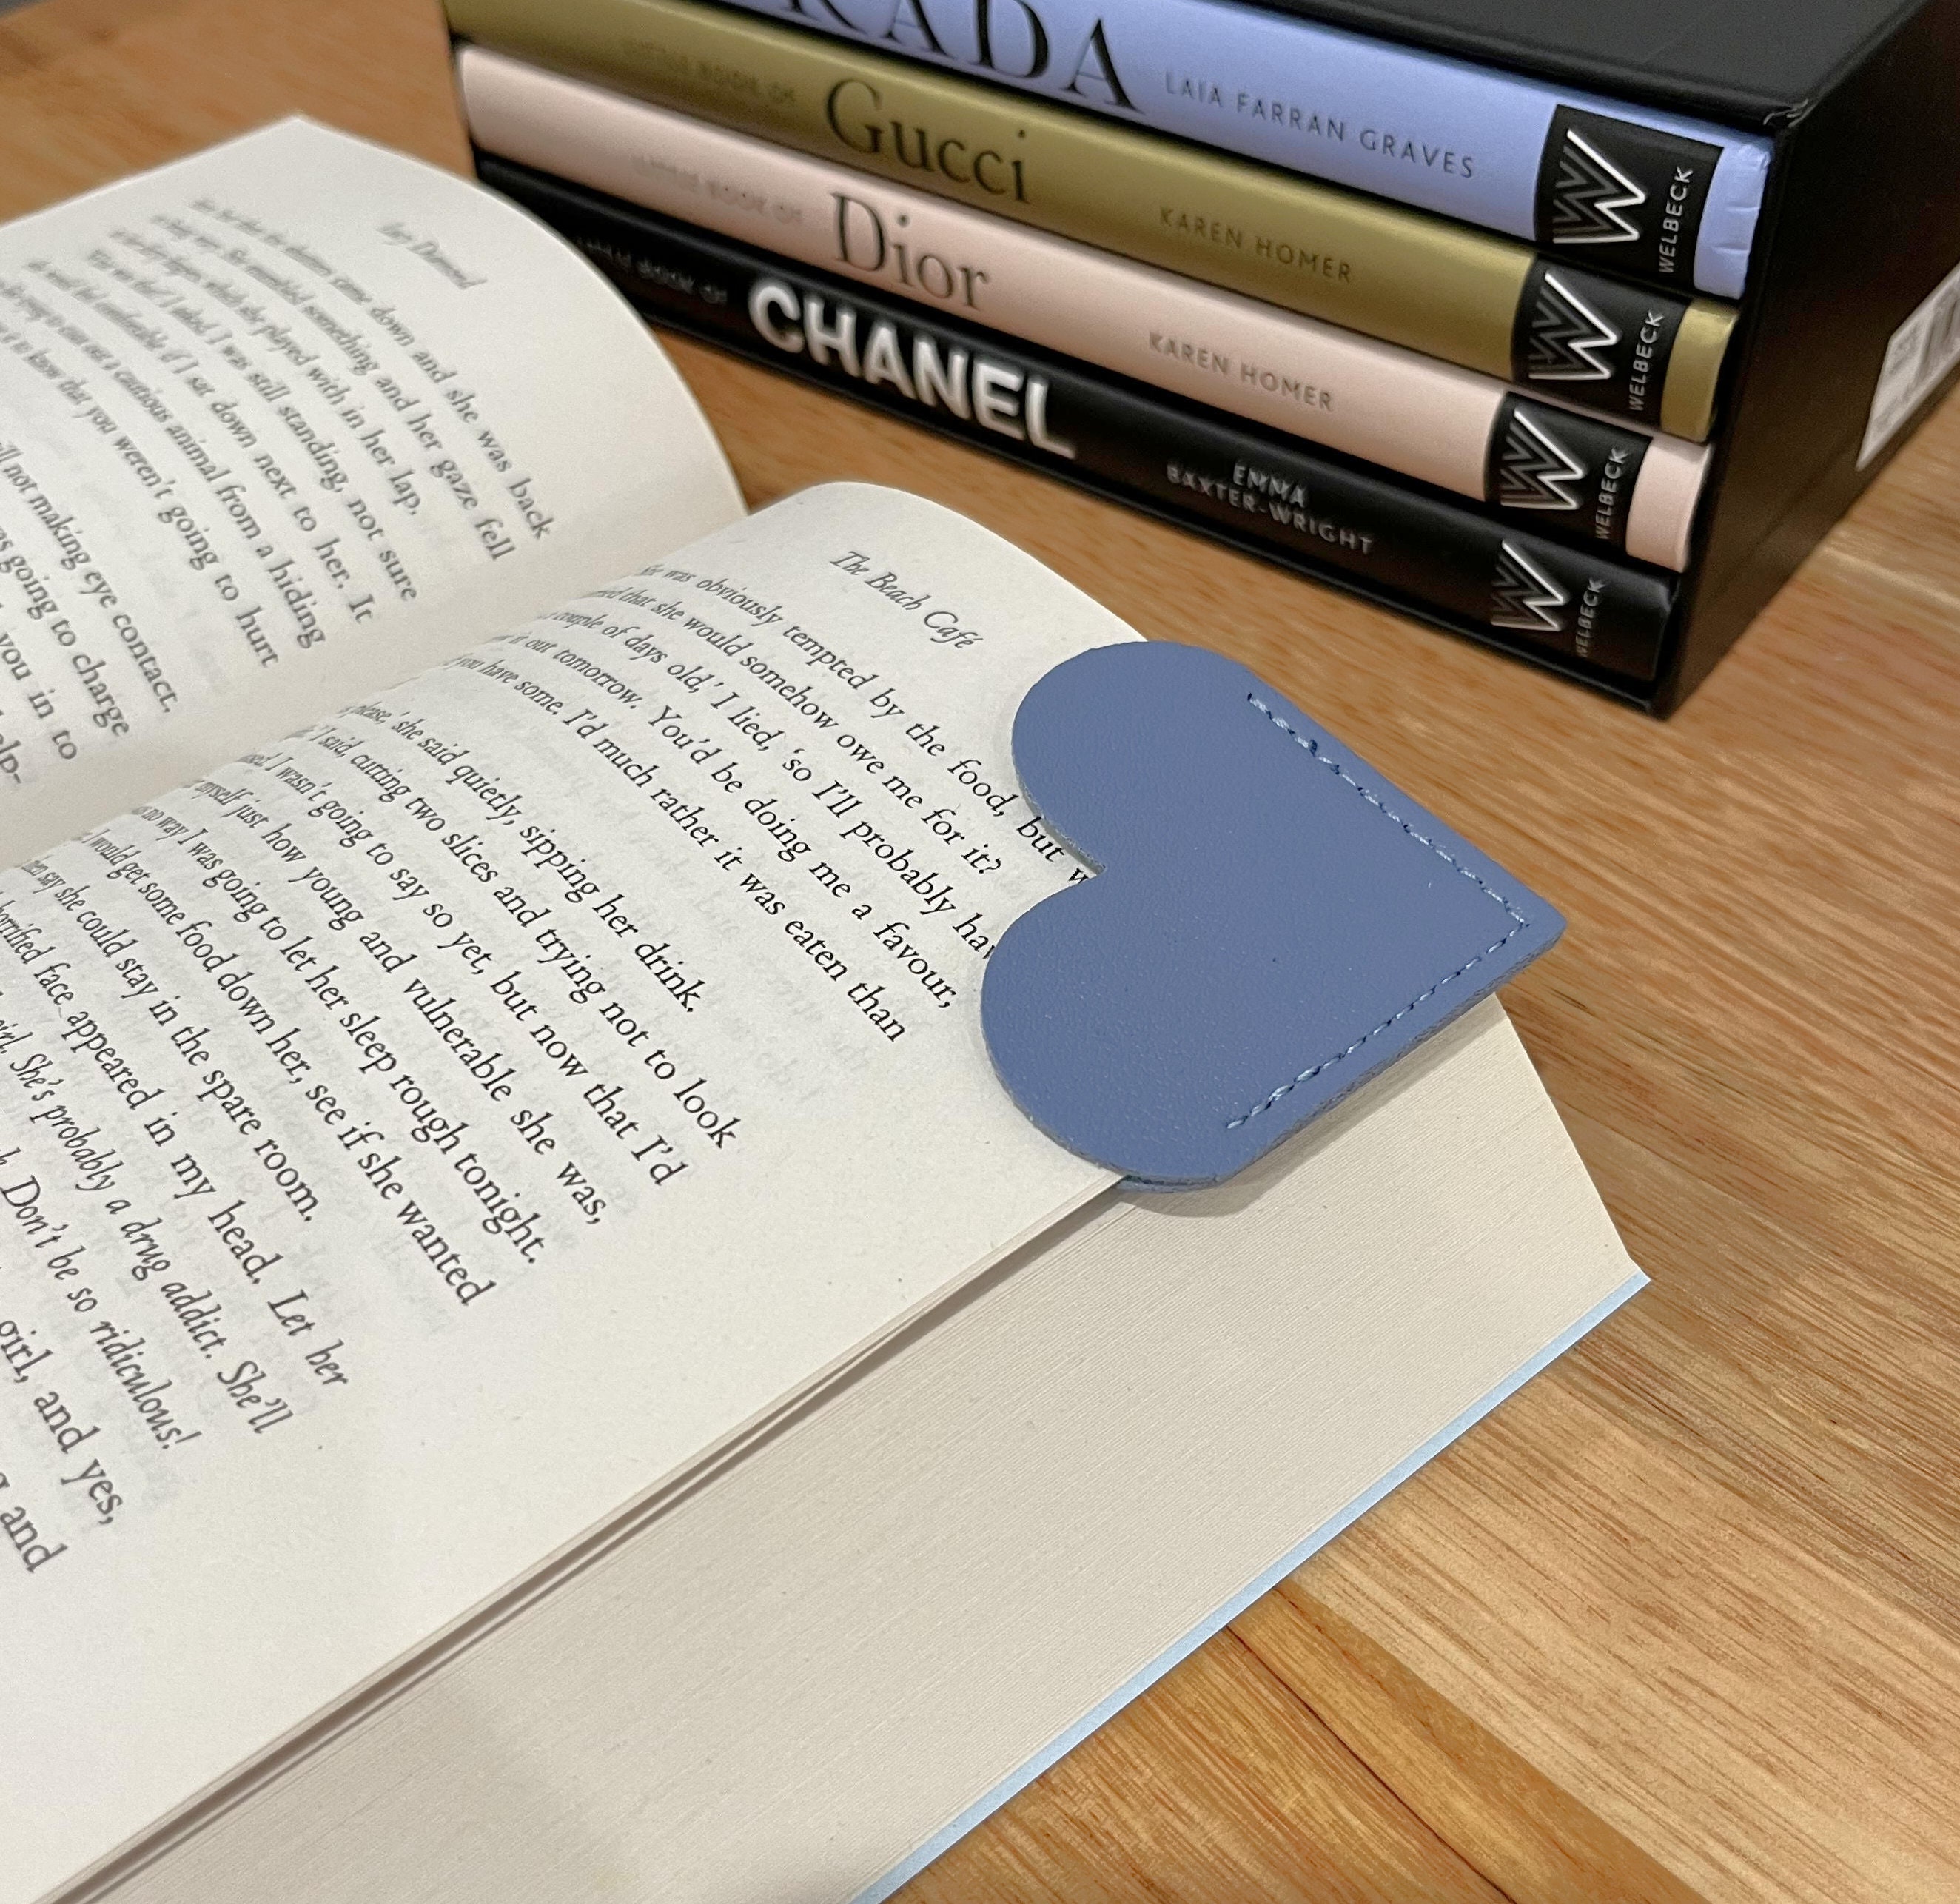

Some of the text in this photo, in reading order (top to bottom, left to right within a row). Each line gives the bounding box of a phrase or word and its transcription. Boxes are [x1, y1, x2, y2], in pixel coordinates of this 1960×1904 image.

[783, 0, 1144, 114] ADA
[825, 78, 1032, 205] Gucci
[1164, 70, 1475, 180] LAIA FARRAN GRAVES
[829, 190, 991, 309] Dior
[1160, 205, 1353, 284] KAREN HOMER
[1659, 165, 1694, 274] WELBECK
[412, 351, 555, 540] and she was back
[747, 278, 1075, 460] CHANEL
[1148, 331, 1334, 411] KAREN HOMER
[1628, 309, 1665, 412] WELBECK
[165, 424, 326, 651] animal from a hiding
[210, 398, 375, 624] down next to her. It
[279, 401, 417, 601] standing, not sure
[360, 429, 421, 516] her lap.
[376, 377, 515, 561] and her gaze fell
[1167, 463, 1373, 555] BAXTER-WRIGHT
[1232, 460, 1308, 509] EMMA
[1594, 446, 1628, 540] WELBECK
[27, 492, 178, 714] making eye contact.
[50, 620, 130, 737] to charge
[158, 506, 279, 668] going to hurt
[829, 550, 984, 650] The Beach Café
[1575, 577, 1605, 659] WELBECK
[28, 688, 77, 760] in to
[625, 635, 956, 916] days I lied, probably
[653, 601, 1002, 875] she would somehow owe me for it?
[697, 577, 1066, 863] obviously tempted by the food, but
[417, 743, 706, 1013] said quietly, sipping her drink.
[514, 680, 906, 1042] some. much rather it was eaten than
[552, 649, 956, 1009] tomorrow. be doing me a favour,
[261, 823, 607, 1225] how young and vulnerable she was,
[308, 799, 640, 1139] going to say so yet, but now that
[350, 754, 412, 803] cutting
[405, 797, 446, 831] two
[442, 833, 498, 883] slices
[493, 885, 553, 928] and
[535, 928, 606, 1005] trying
[599, 1002, 649, 1047] not
[644, 1048, 676, 1079] to
[673, 1077, 741, 1149] look
[55, 885, 319, 1222] she could stay in the spare room.
[106, 862, 498, 1307] get some food down her, see if she wanted
[177, 828, 546, 1264] I was going to let her sleep rough tonight.
[30, 1104, 227, 1360] probably a drug addict.
[33, 962, 316, 1336] face appeared in my head. Let
[47, 1245, 203, 1449] be so ridiculous!
[0, 1505, 68, 1572] and
[33, 1390, 123, 1525] and yes,
